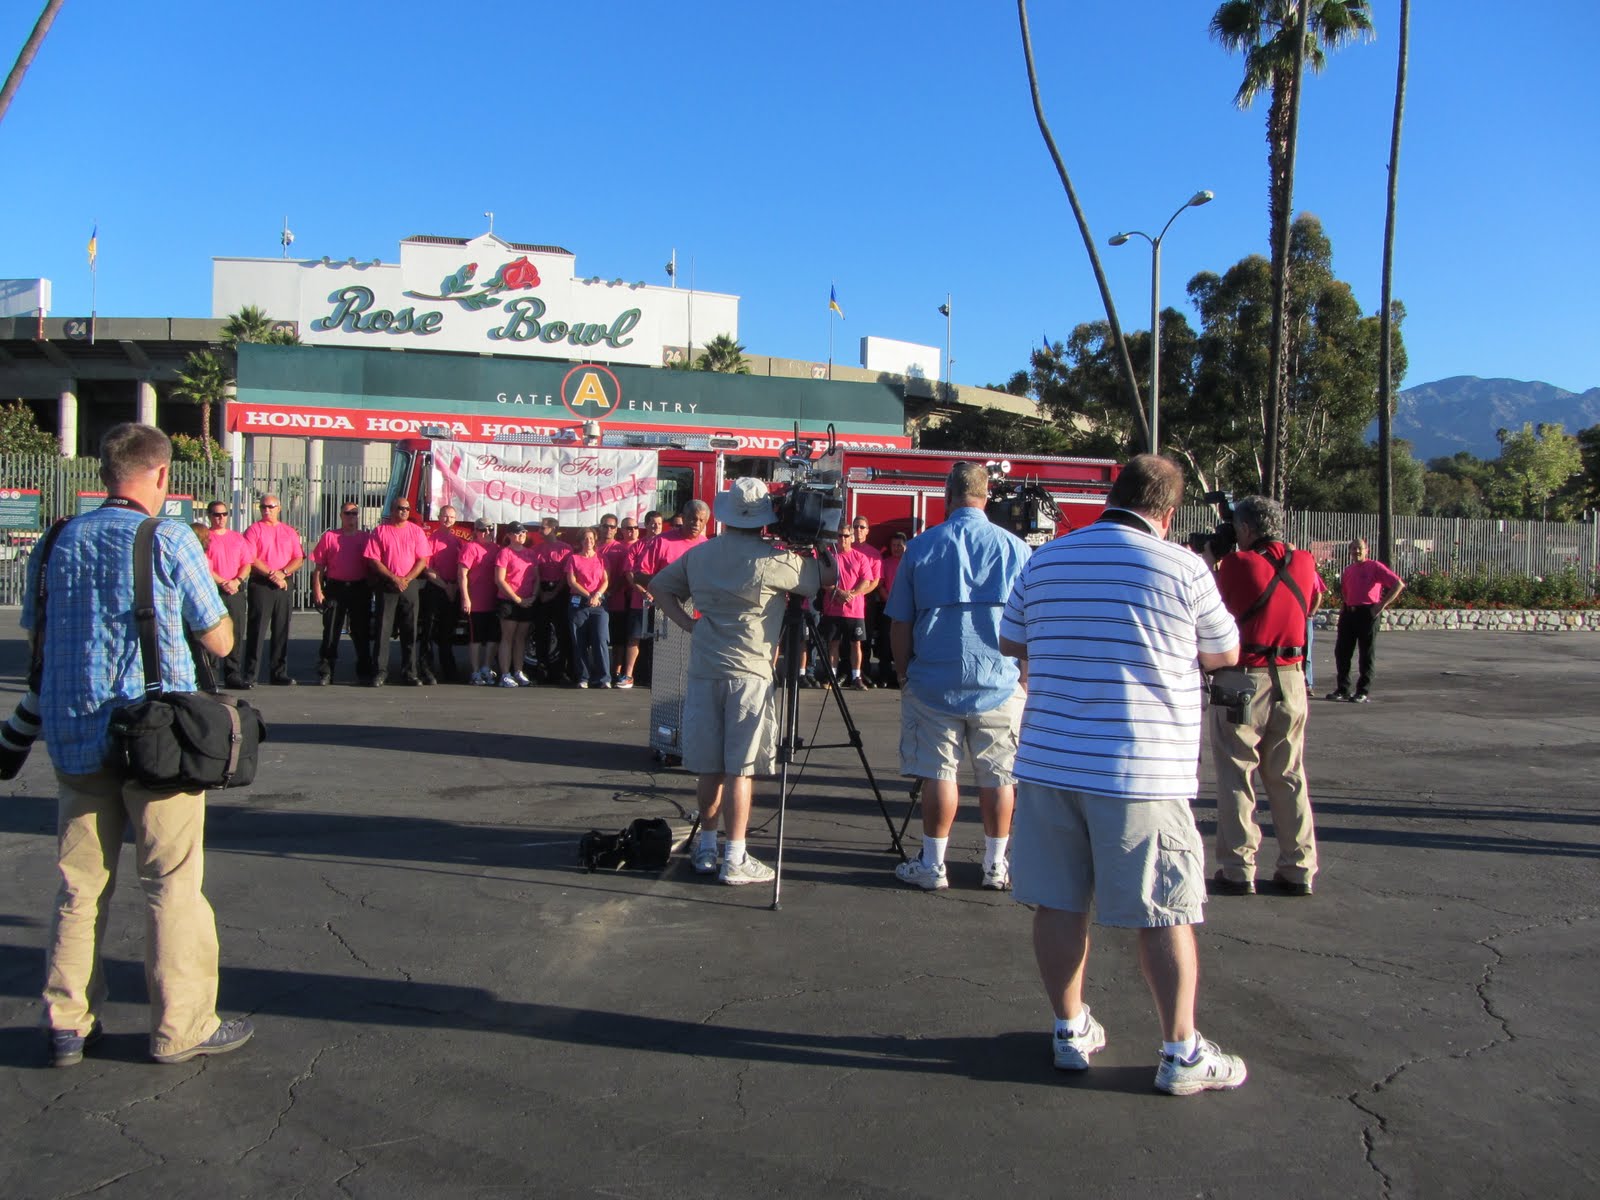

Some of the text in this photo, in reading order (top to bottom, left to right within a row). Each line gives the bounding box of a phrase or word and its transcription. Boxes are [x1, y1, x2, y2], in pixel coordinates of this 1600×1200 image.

[319, 285, 643, 349] Rose Bowl
[70, 322, 87, 335] 24
[666, 350, 682, 362] 26
[813, 367, 826, 379] 27
[496, 372, 698, 414] GATE A ENTRY
[245, 411, 355, 430] HONDA
[475, 453, 615, 477] Pasadena Fire
[484, 473, 648, 515] Goes Pink
